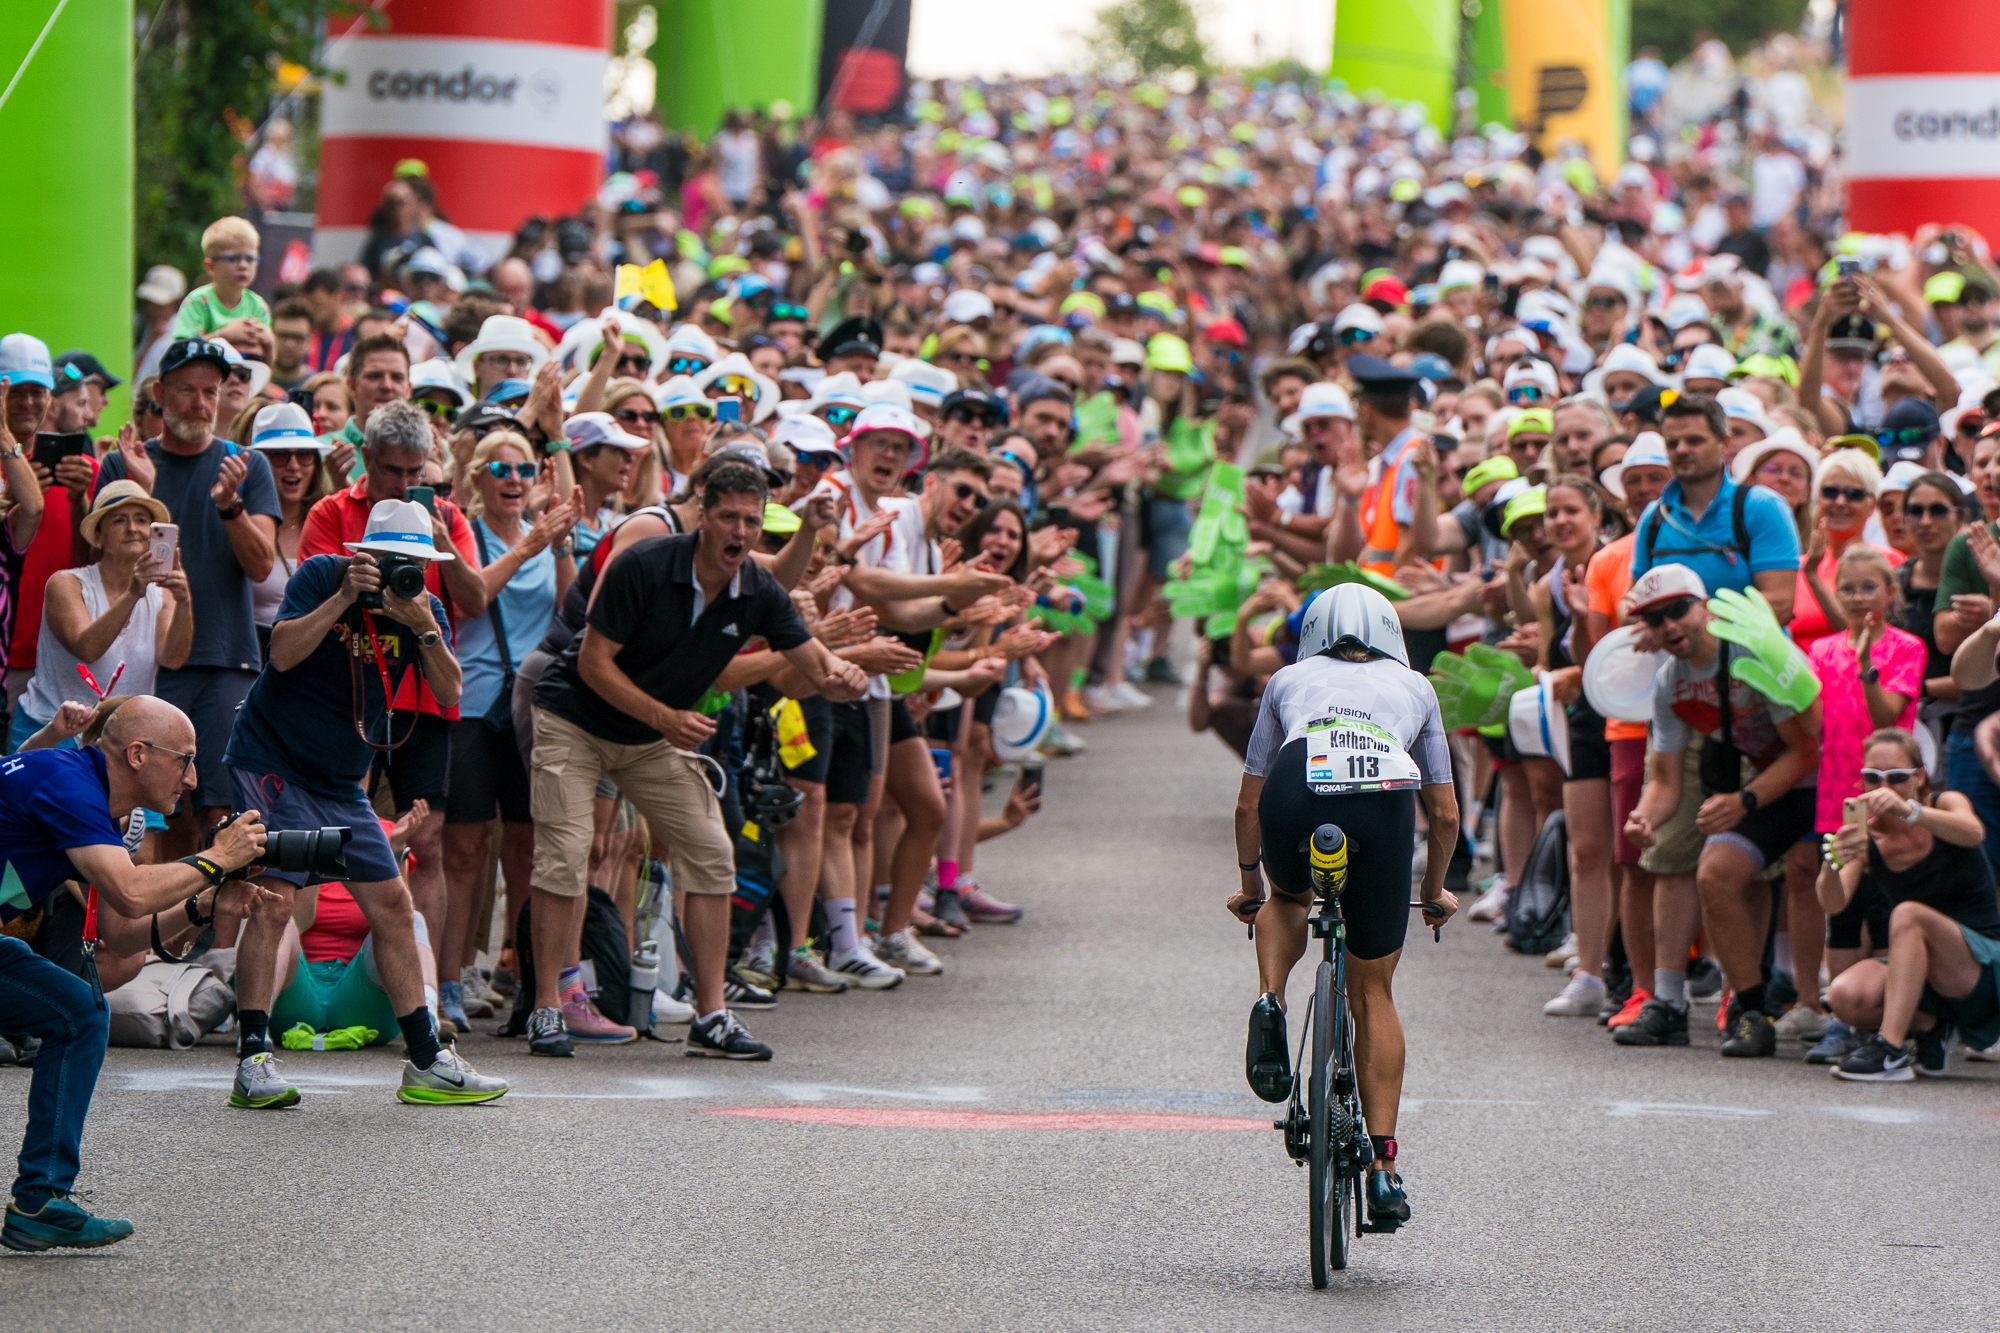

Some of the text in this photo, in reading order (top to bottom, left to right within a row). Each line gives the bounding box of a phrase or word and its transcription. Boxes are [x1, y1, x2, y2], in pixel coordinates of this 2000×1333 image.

[367, 62, 519, 105] condor
[1893, 104, 2000, 142] cond
[1328, 706, 1371, 720] FUSION
[1346, 755, 1379, 779] 113
[1315, 784, 1341, 793] HOKA
[197, 860, 216, 873] Nikon
